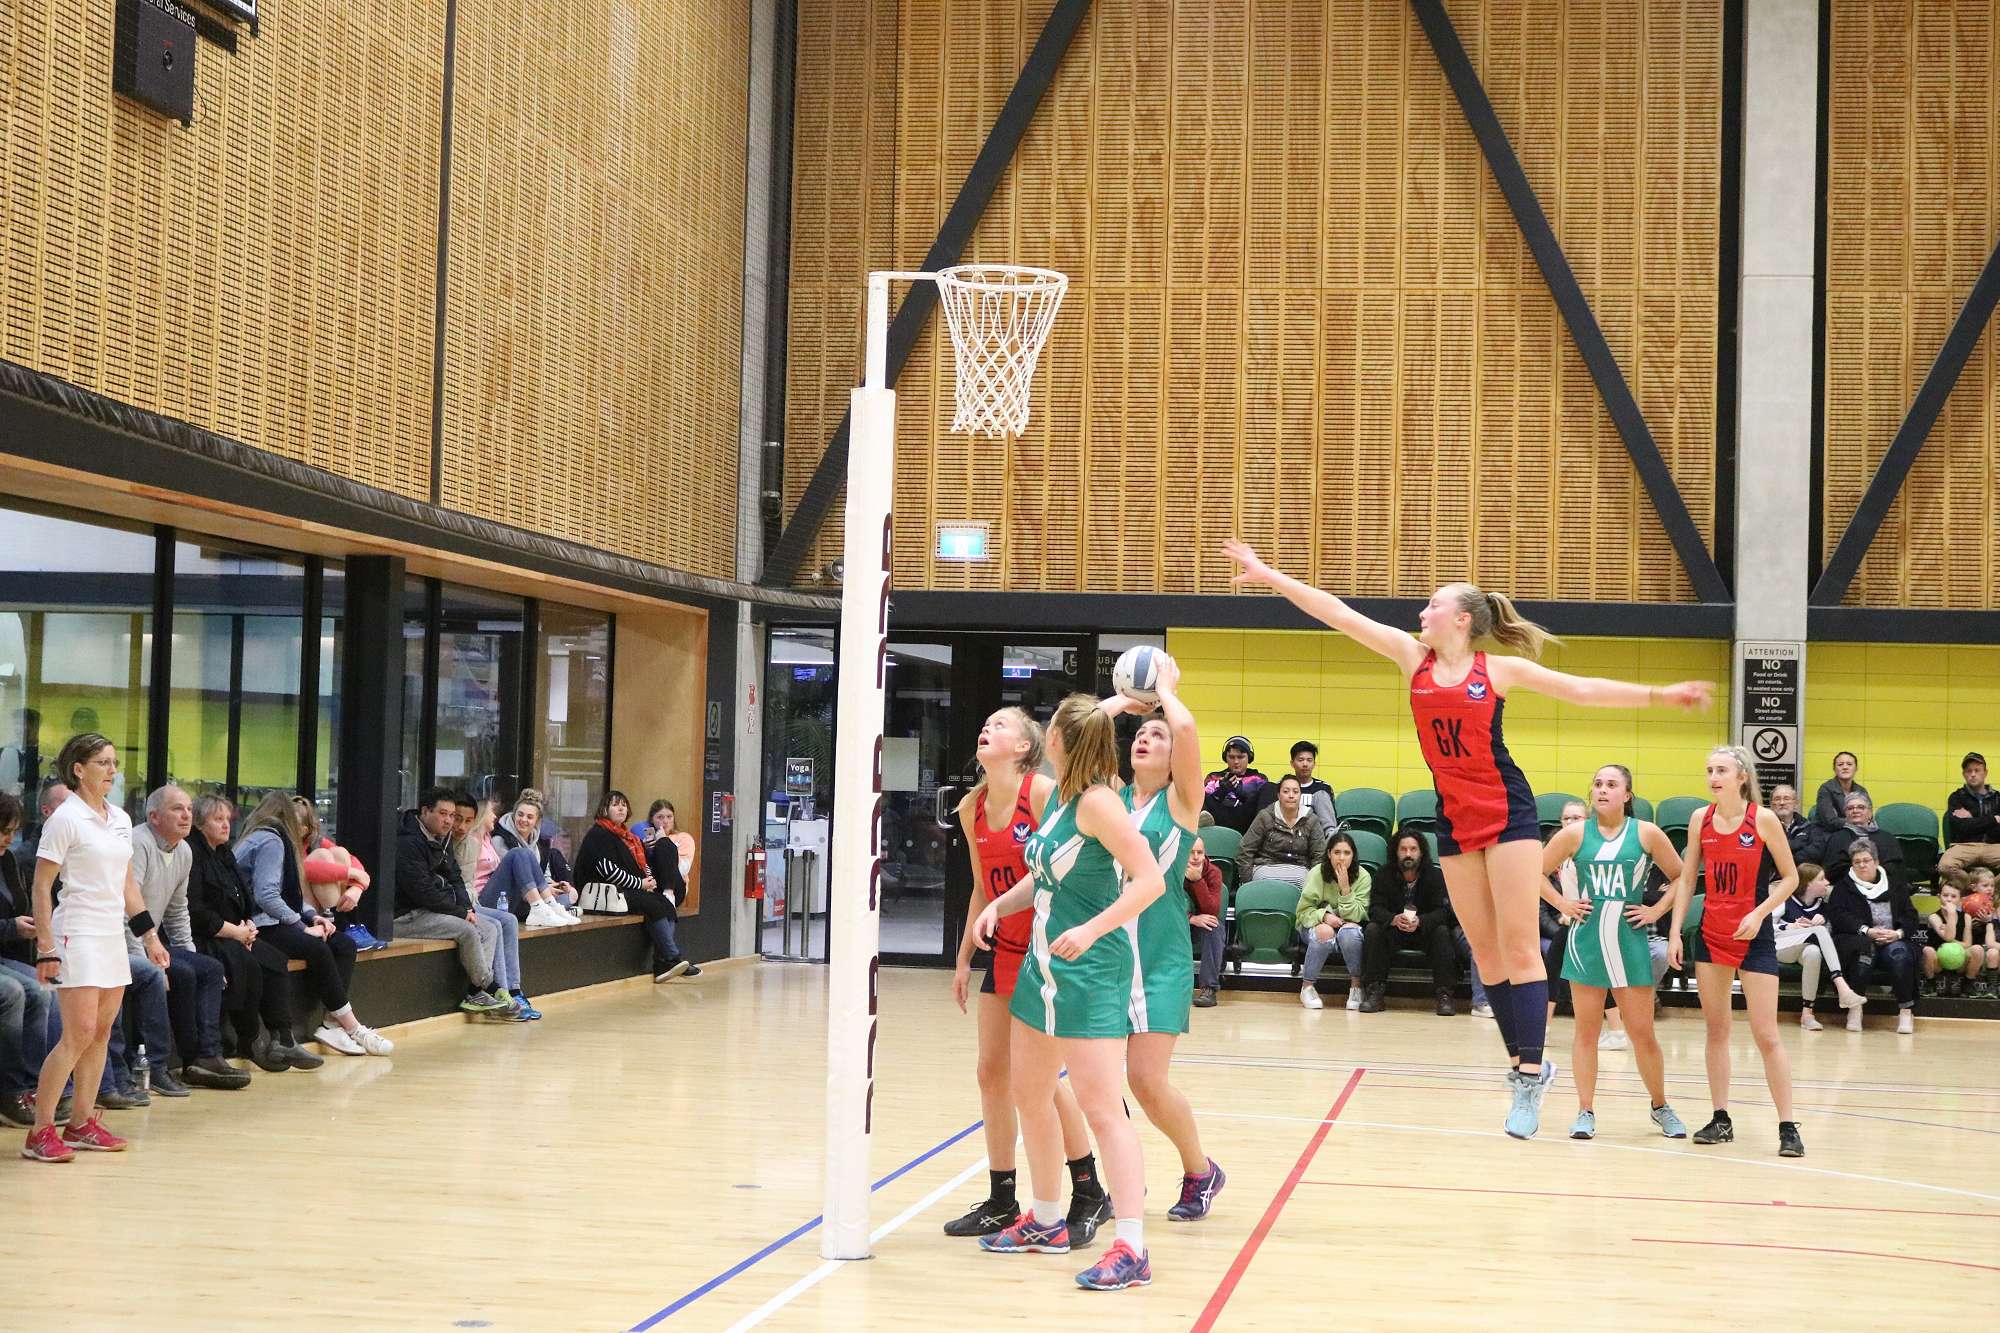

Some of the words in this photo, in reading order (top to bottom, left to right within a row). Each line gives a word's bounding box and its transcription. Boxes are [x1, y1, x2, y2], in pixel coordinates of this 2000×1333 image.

[164, 0, 196, 28] Services
[1748, 648, 1794, 656] ATTENTION
[1096, 656, 1117, 665] UBL
[1762, 660, 1781, 670] NO
[1761, 697, 1781, 707] NO
[1432, 718, 1472, 758] GK
[790, 763, 810, 774] Yoga
[1589, 863, 1627, 898] WA
[1713, 861, 1738, 896] WD
